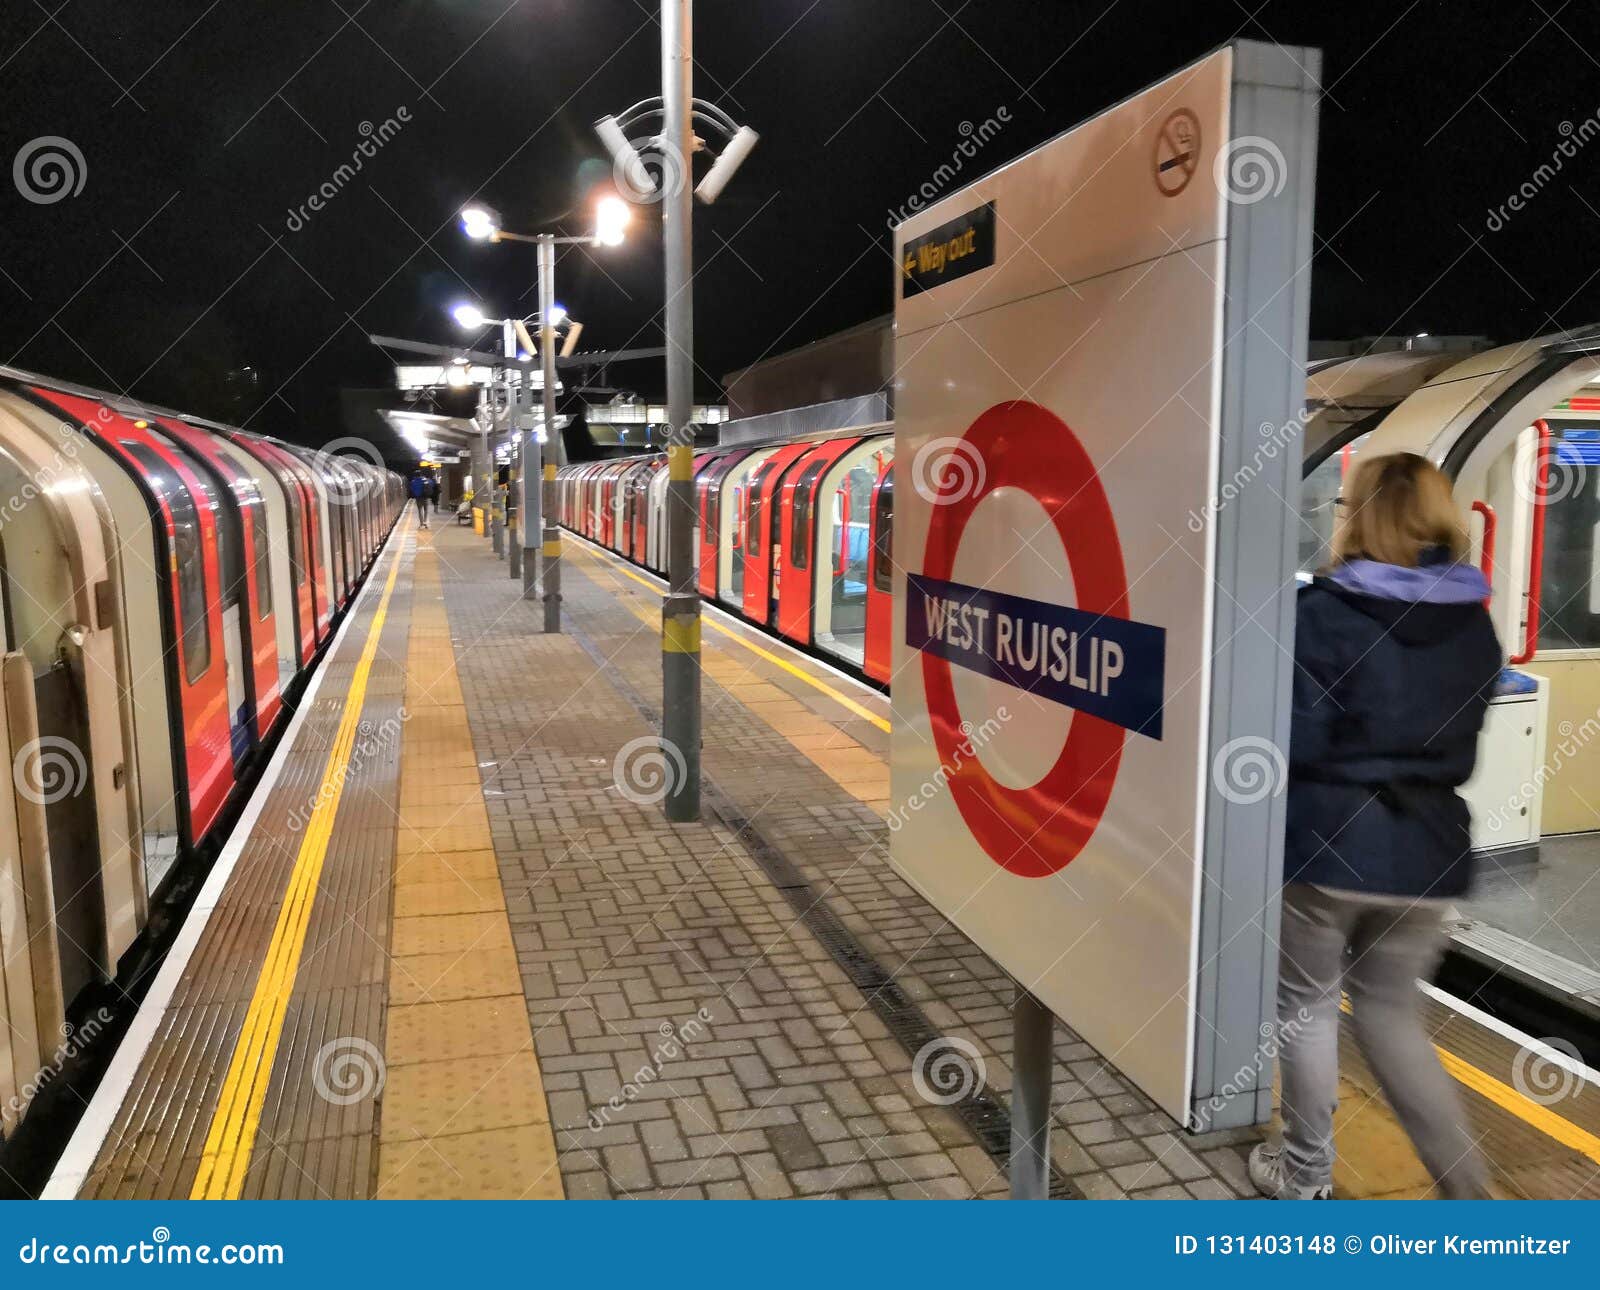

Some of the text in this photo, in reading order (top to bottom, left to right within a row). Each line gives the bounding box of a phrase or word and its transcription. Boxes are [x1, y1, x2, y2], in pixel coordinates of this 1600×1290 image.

[918, 226, 977, 274] Way out
[924, 593, 1126, 697] WEST RUISLIP
